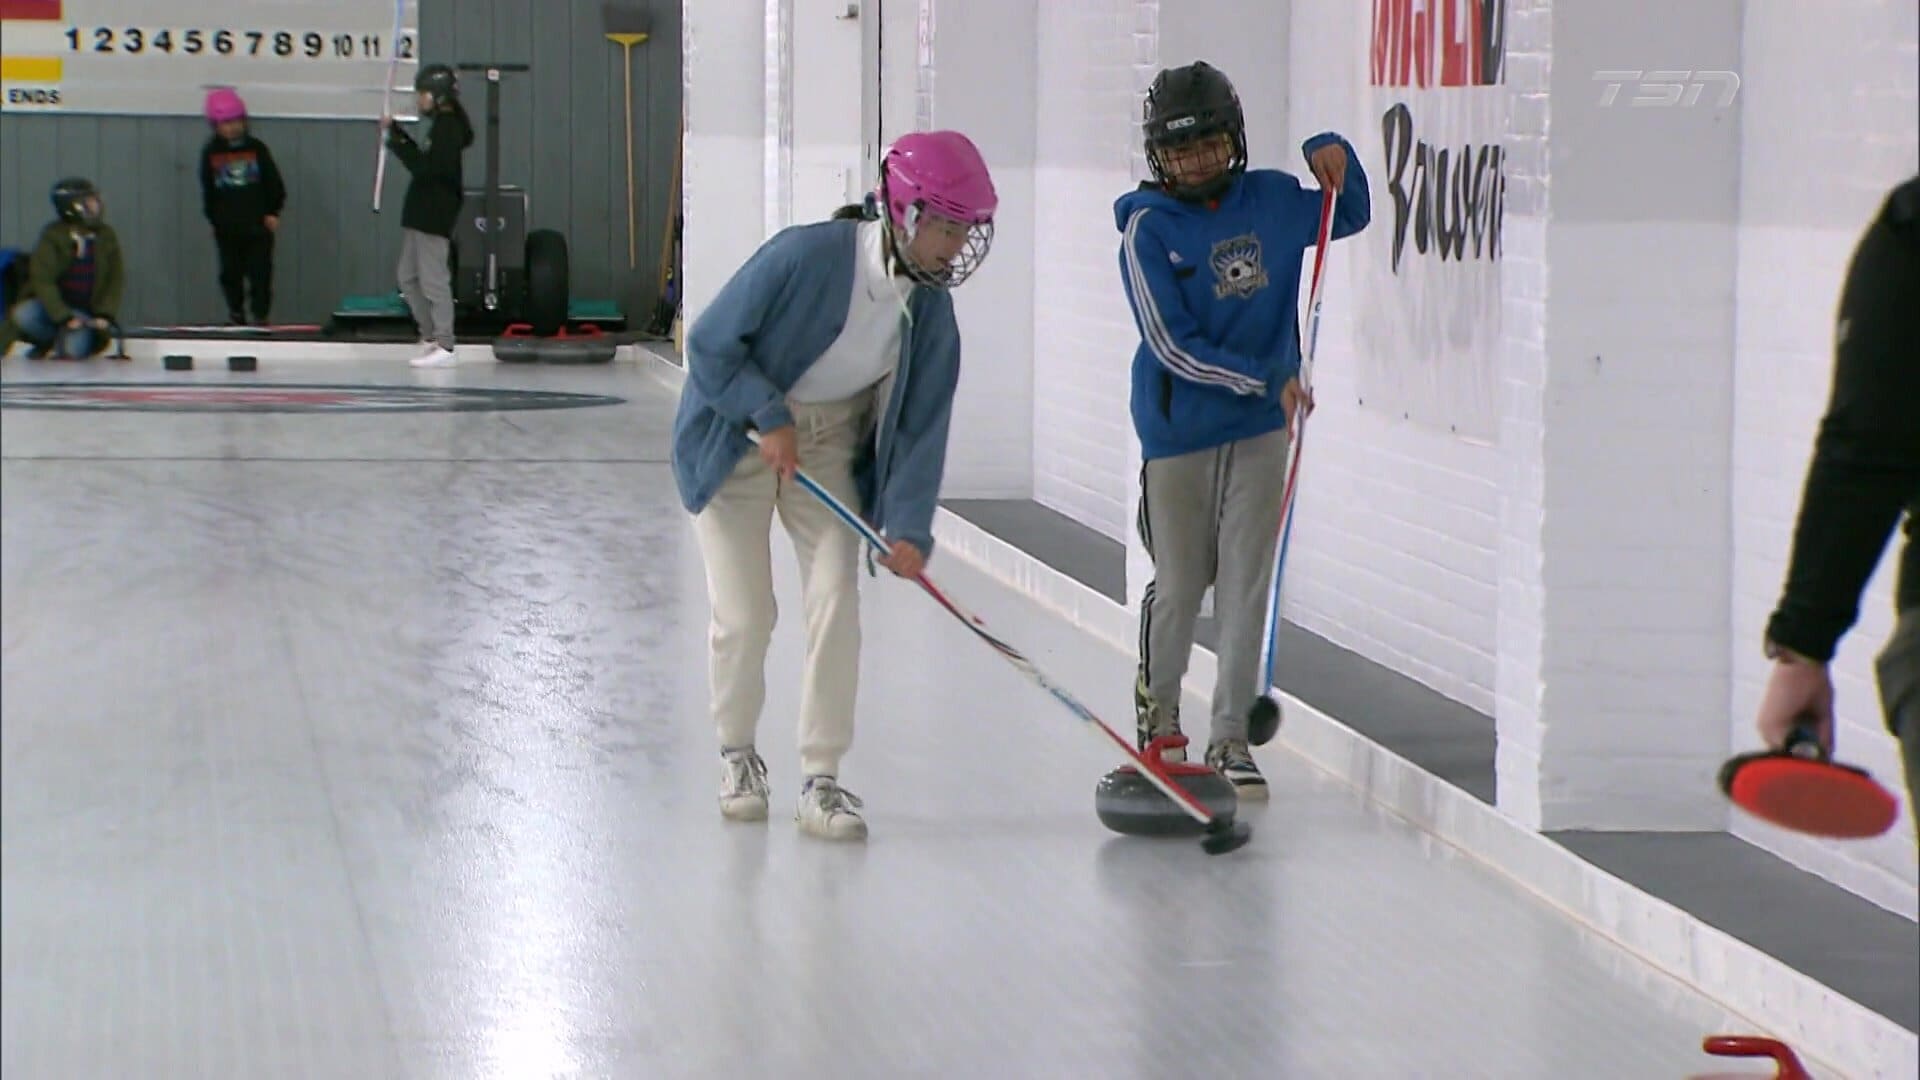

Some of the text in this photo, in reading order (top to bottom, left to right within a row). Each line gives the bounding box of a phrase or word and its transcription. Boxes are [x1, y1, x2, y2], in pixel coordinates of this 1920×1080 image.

[64, 27, 78, 50] 1
[94, 27, 113, 51] 2
[124, 28, 142, 53] 3
[153, 29, 172, 53] 4
[184, 30, 203, 53] 5
[214, 30, 233, 54] 6
[245, 31, 263, 55] 7
[274, 32, 292, 56] 8
[303, 32, 322, 57] 9
[332, 34, 352, 58] 10
[362, 35, 379, 57] 11
[8, 88, 61, 105] ENDS
